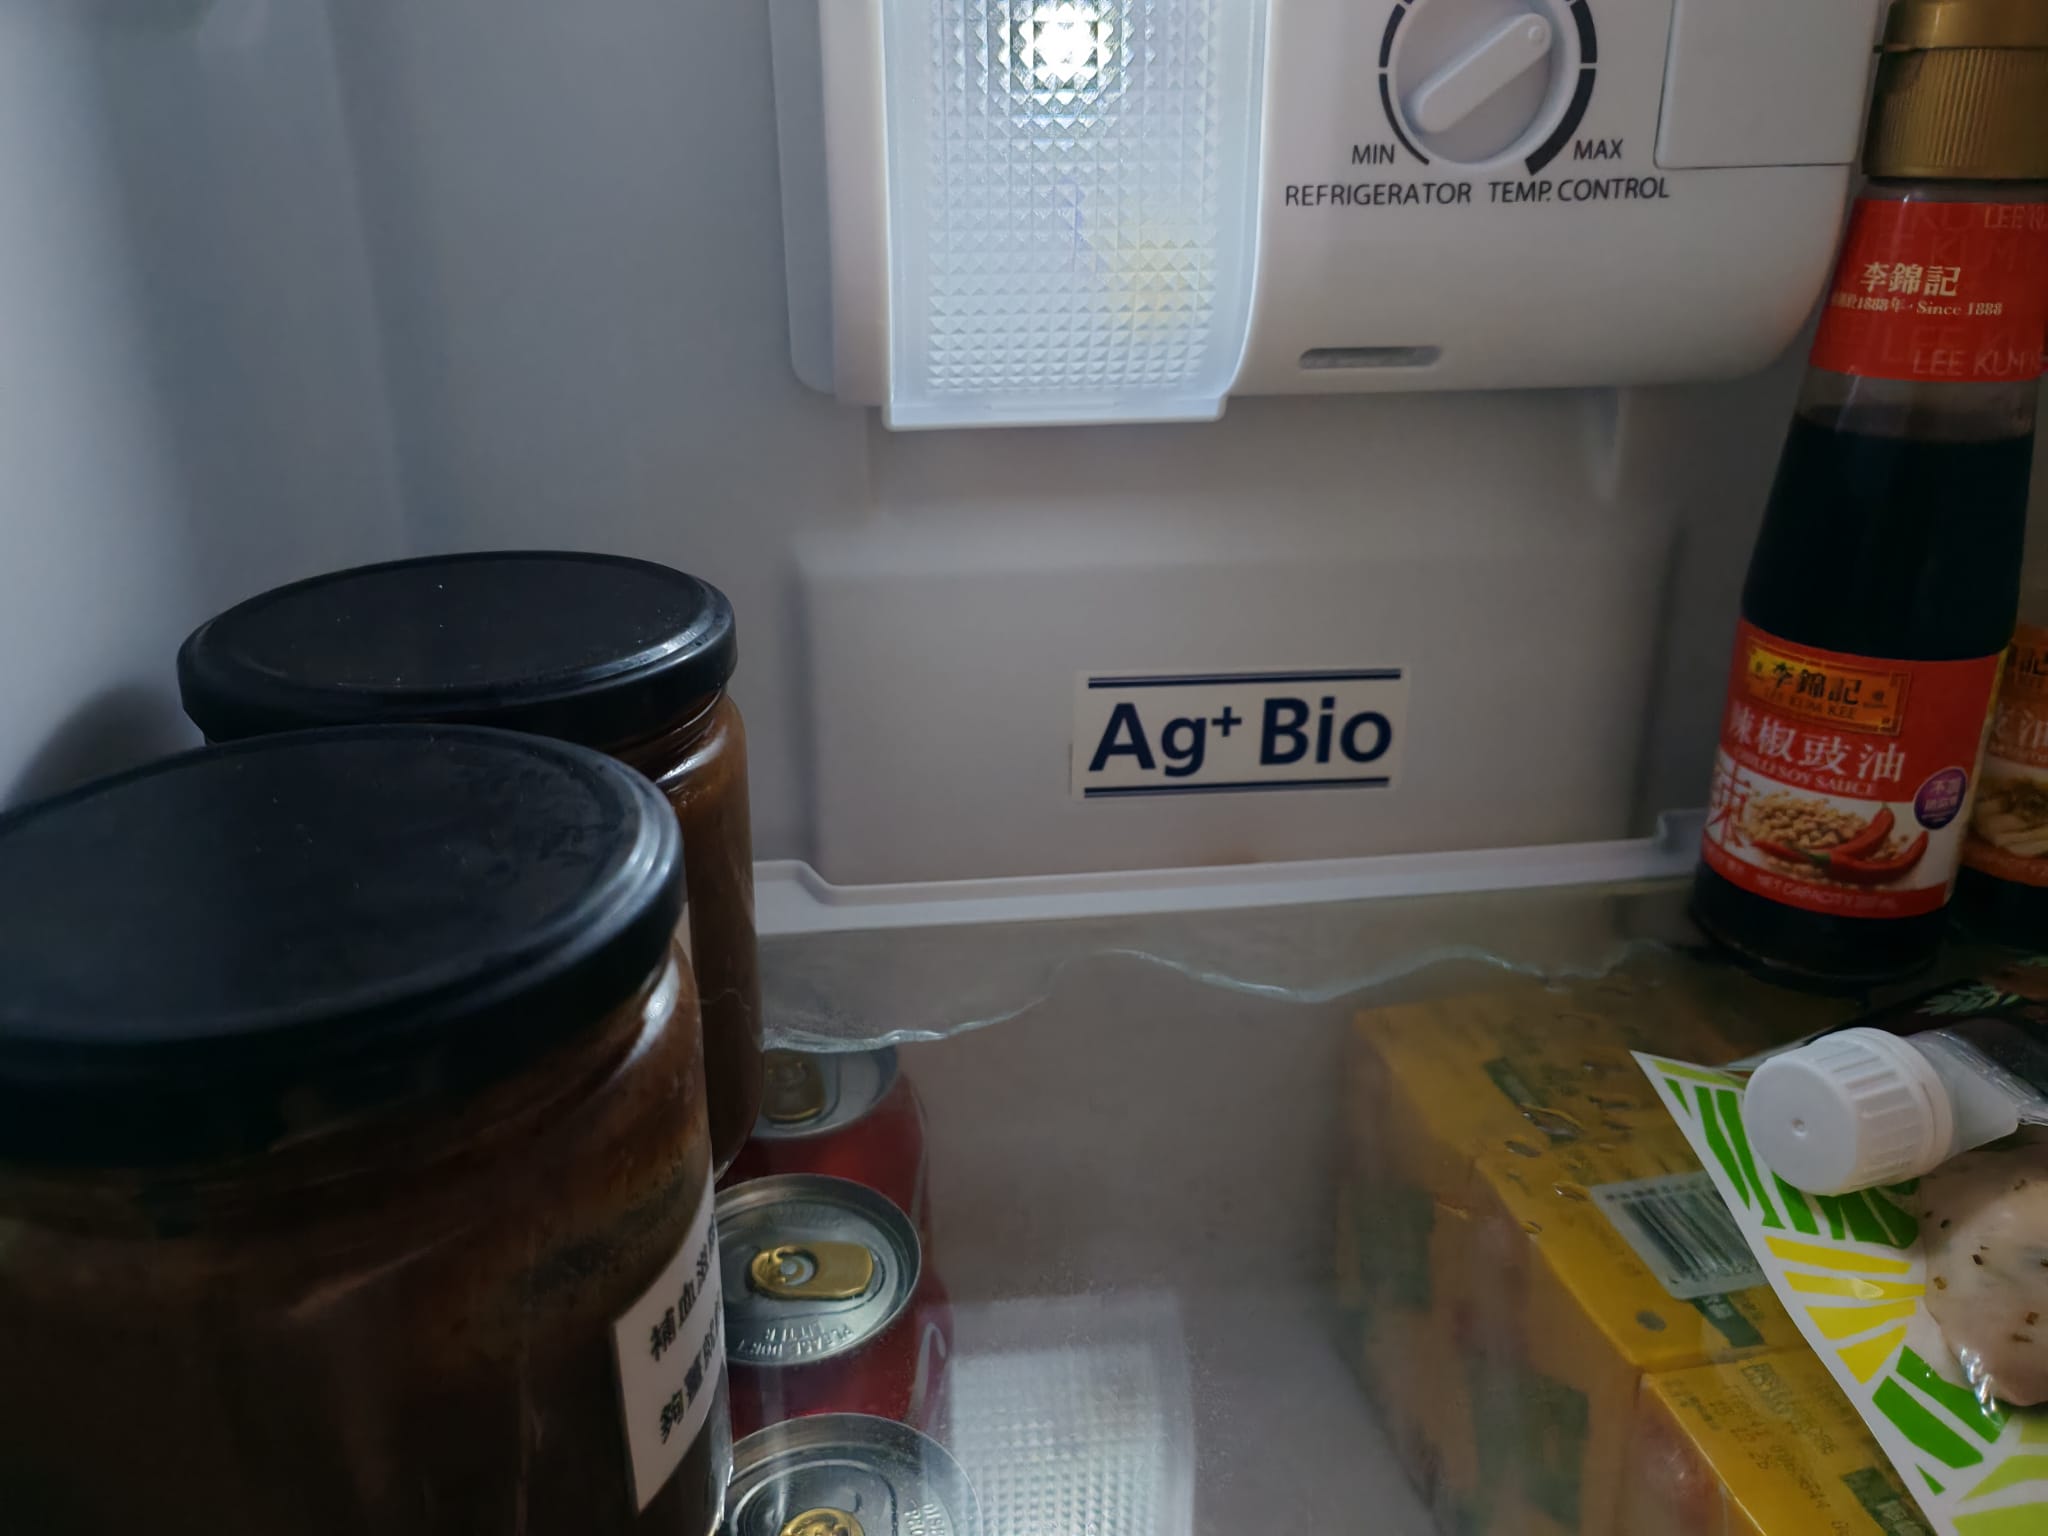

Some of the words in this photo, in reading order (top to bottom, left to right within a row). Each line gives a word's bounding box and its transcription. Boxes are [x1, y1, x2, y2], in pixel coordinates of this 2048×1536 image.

[1352, 144, 1396, 165] MIN
[1574, 138, 1624, 161] MAX
[1286, 182, 1472, 207] REFRIGERATOR
[1860, 261, 1961, 297] 李錦記
[1916, 299, 1962, 316] Since
[1967, 301, 2003, 317] 1888
[1827, 703, 1858, 720] KEE
[1260, 696, 1392, 766] Bio
[1728, 702, 1906, 783] 辣椒豉油
[1778, 764, 1811, 785] SOY
[1815, 773, 1876, 797] SAUCE
